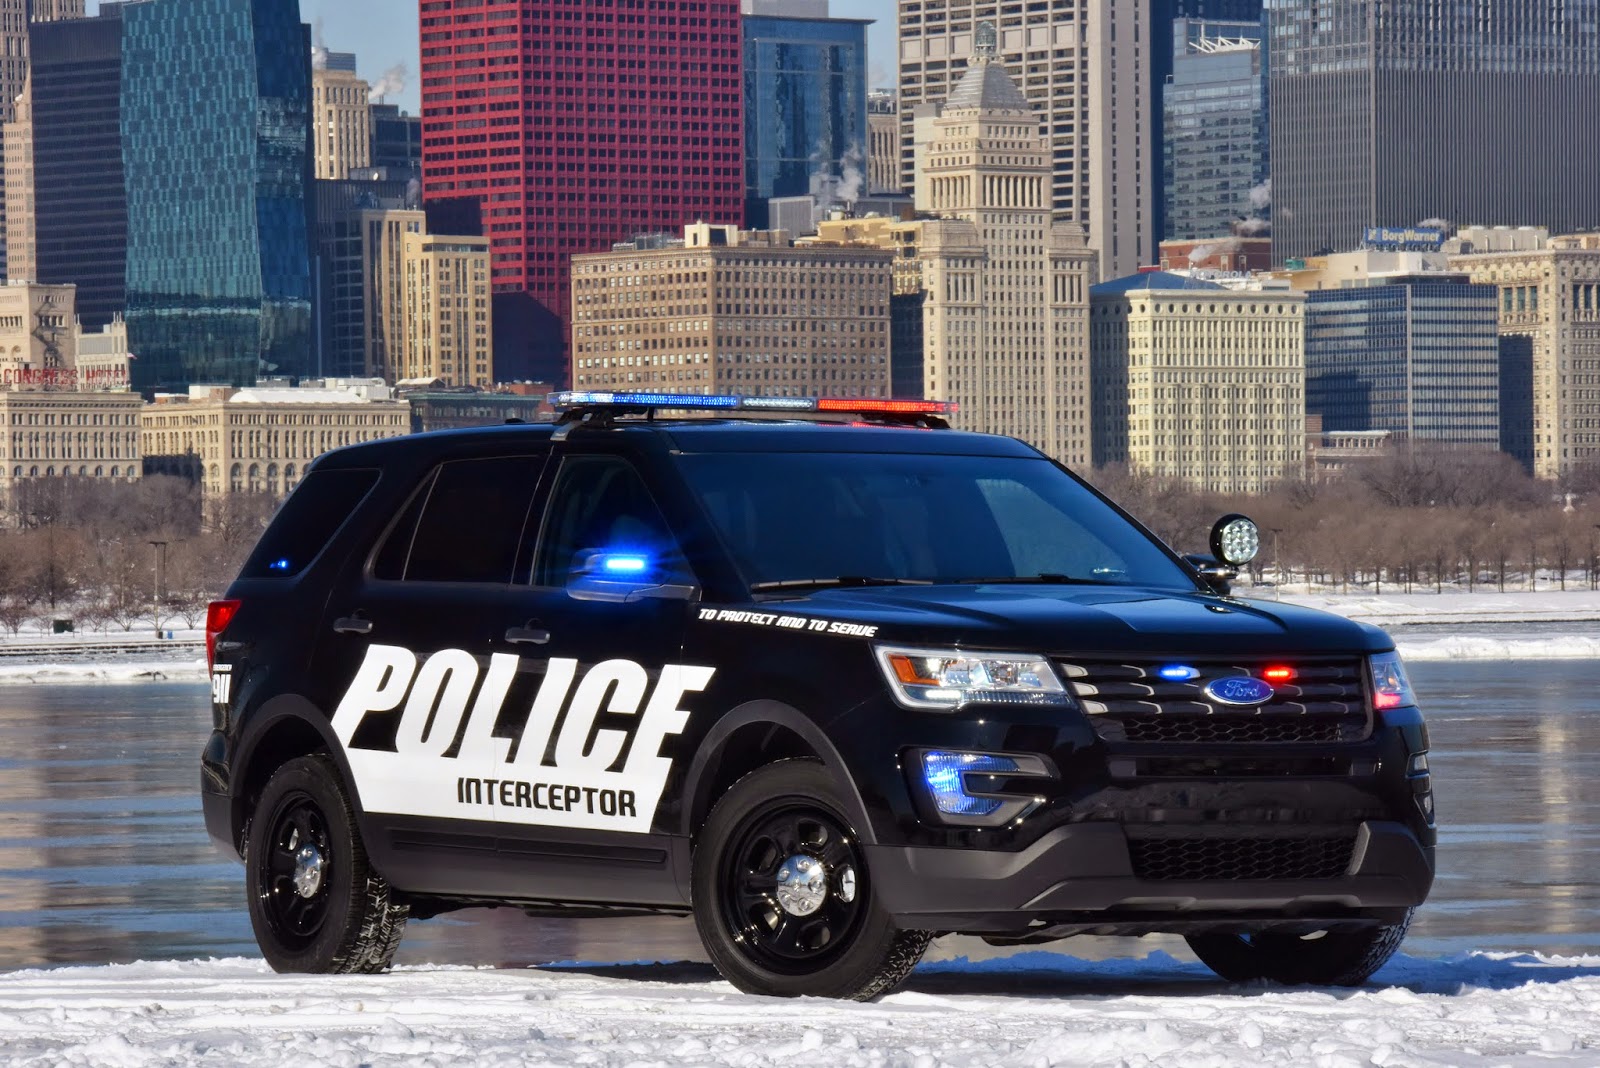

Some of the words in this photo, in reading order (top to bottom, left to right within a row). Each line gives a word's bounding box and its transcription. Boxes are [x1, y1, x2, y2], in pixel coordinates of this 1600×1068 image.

[1381, 228, 1440, 244] BorgWarner
[4, 368, 78, 385] CONGRESS
[699, 608, 717, 620] TO
[716, 610, 777, 625] PROTECT
[776, 615, 807, 629] AND
[808, 619, 828, 631] TO
[827, 622, 878, 637] SERVE
[213, 673, 231, 703] 911
[1225, 680, 1260, 697] Ford
[331, 644, 716, 773] POLICE
[457, 777, 636, 817] INTERCEPTOR
